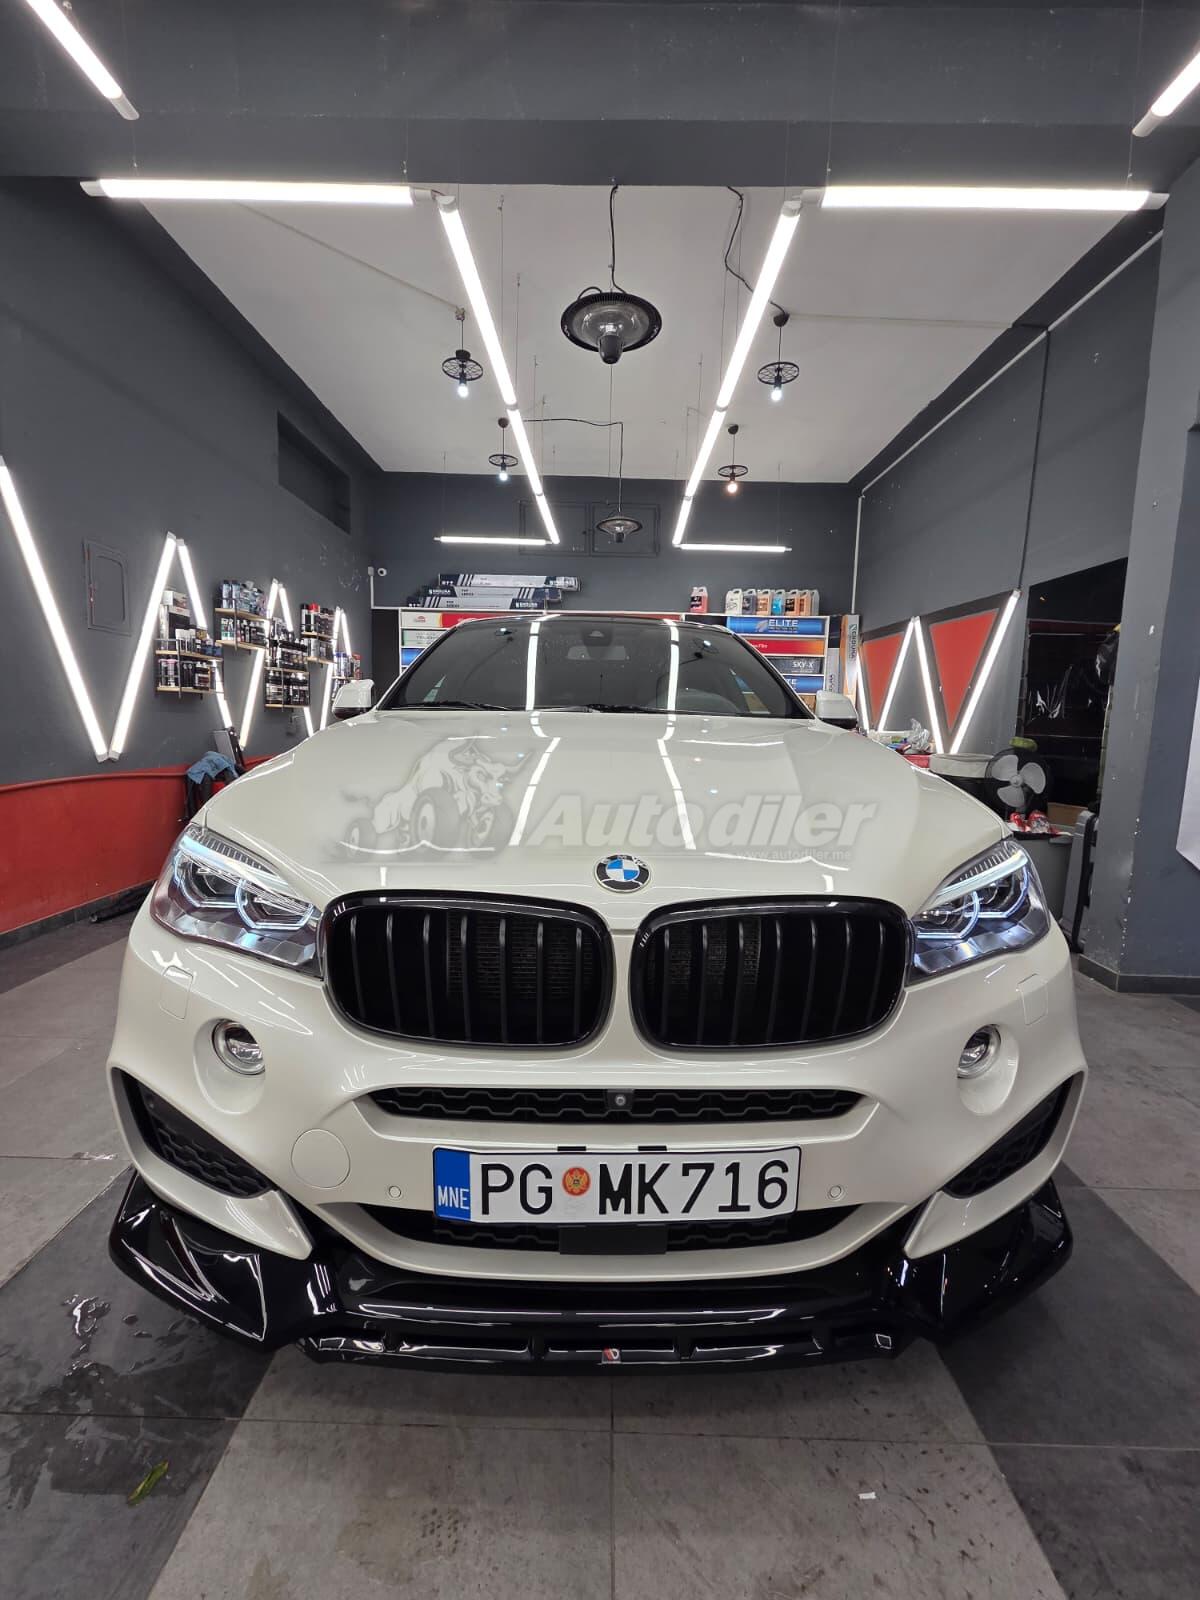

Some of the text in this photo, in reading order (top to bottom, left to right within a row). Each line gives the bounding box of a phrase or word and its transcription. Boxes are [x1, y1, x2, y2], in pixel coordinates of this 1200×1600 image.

[768, 619, 798, 627] ELITE
[437, 1185, 470, 1210] MNE
[480, 1162, 553, 1215] PG
